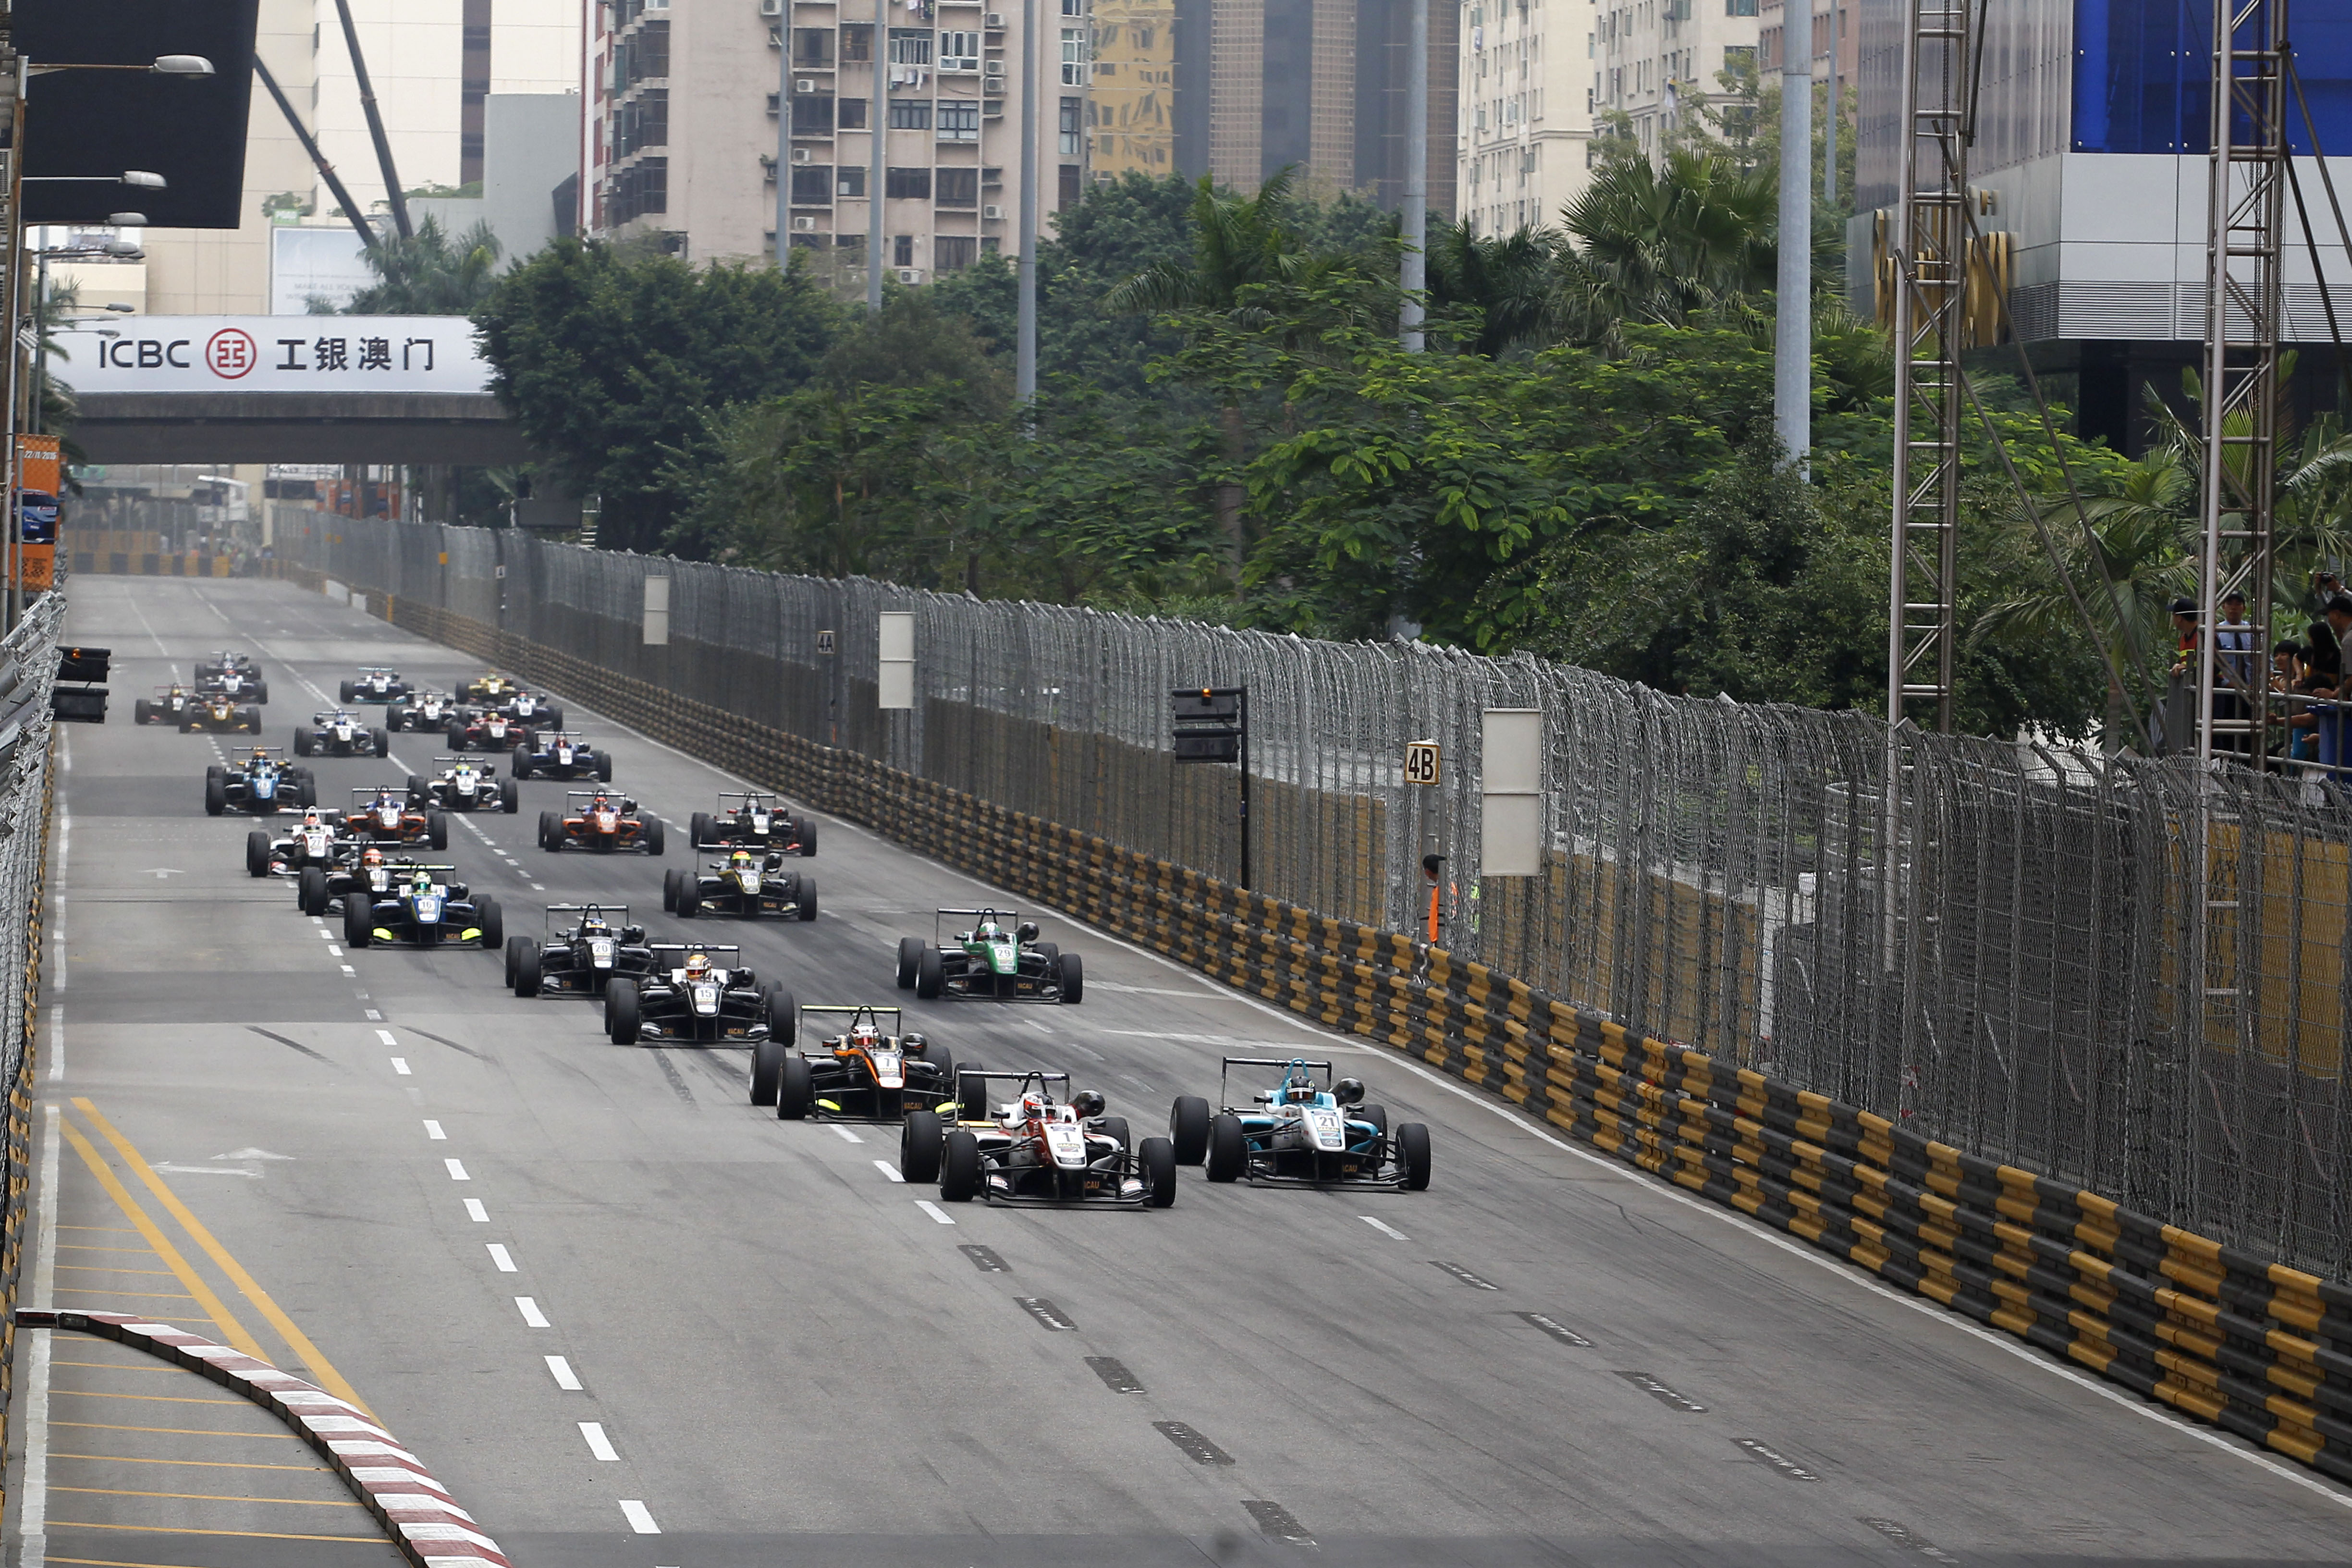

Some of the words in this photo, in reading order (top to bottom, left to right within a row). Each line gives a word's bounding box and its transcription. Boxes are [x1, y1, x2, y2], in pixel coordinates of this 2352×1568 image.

[100, 340, 190, 368] ICBC
[276, 337, 433, 371] 工银澳门
[819, 635, 834, 651] 4A
[1408, 748, 1433, 780] 4B
[700, 990, 712, 998] 15
[1319, 1116, 1335, 1127] 21
[1063, 1132, 1071, 1142] 1
